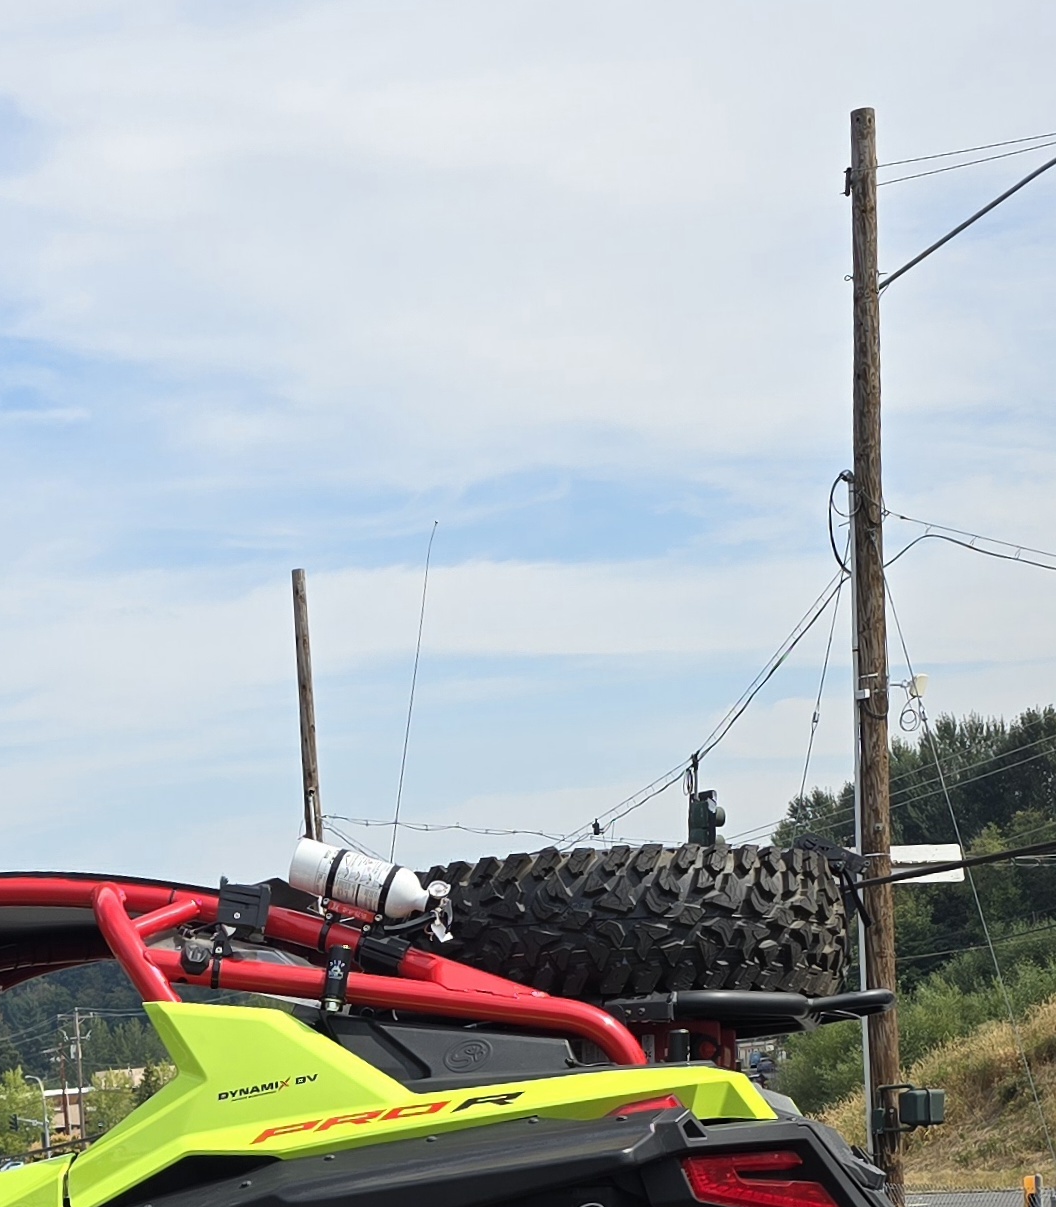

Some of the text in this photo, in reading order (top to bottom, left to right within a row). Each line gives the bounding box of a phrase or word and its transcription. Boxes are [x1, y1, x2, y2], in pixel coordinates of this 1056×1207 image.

[218, 1076, 291, 1101] DYNAMIX
[250, 1091, 525, 1145] PRO R
